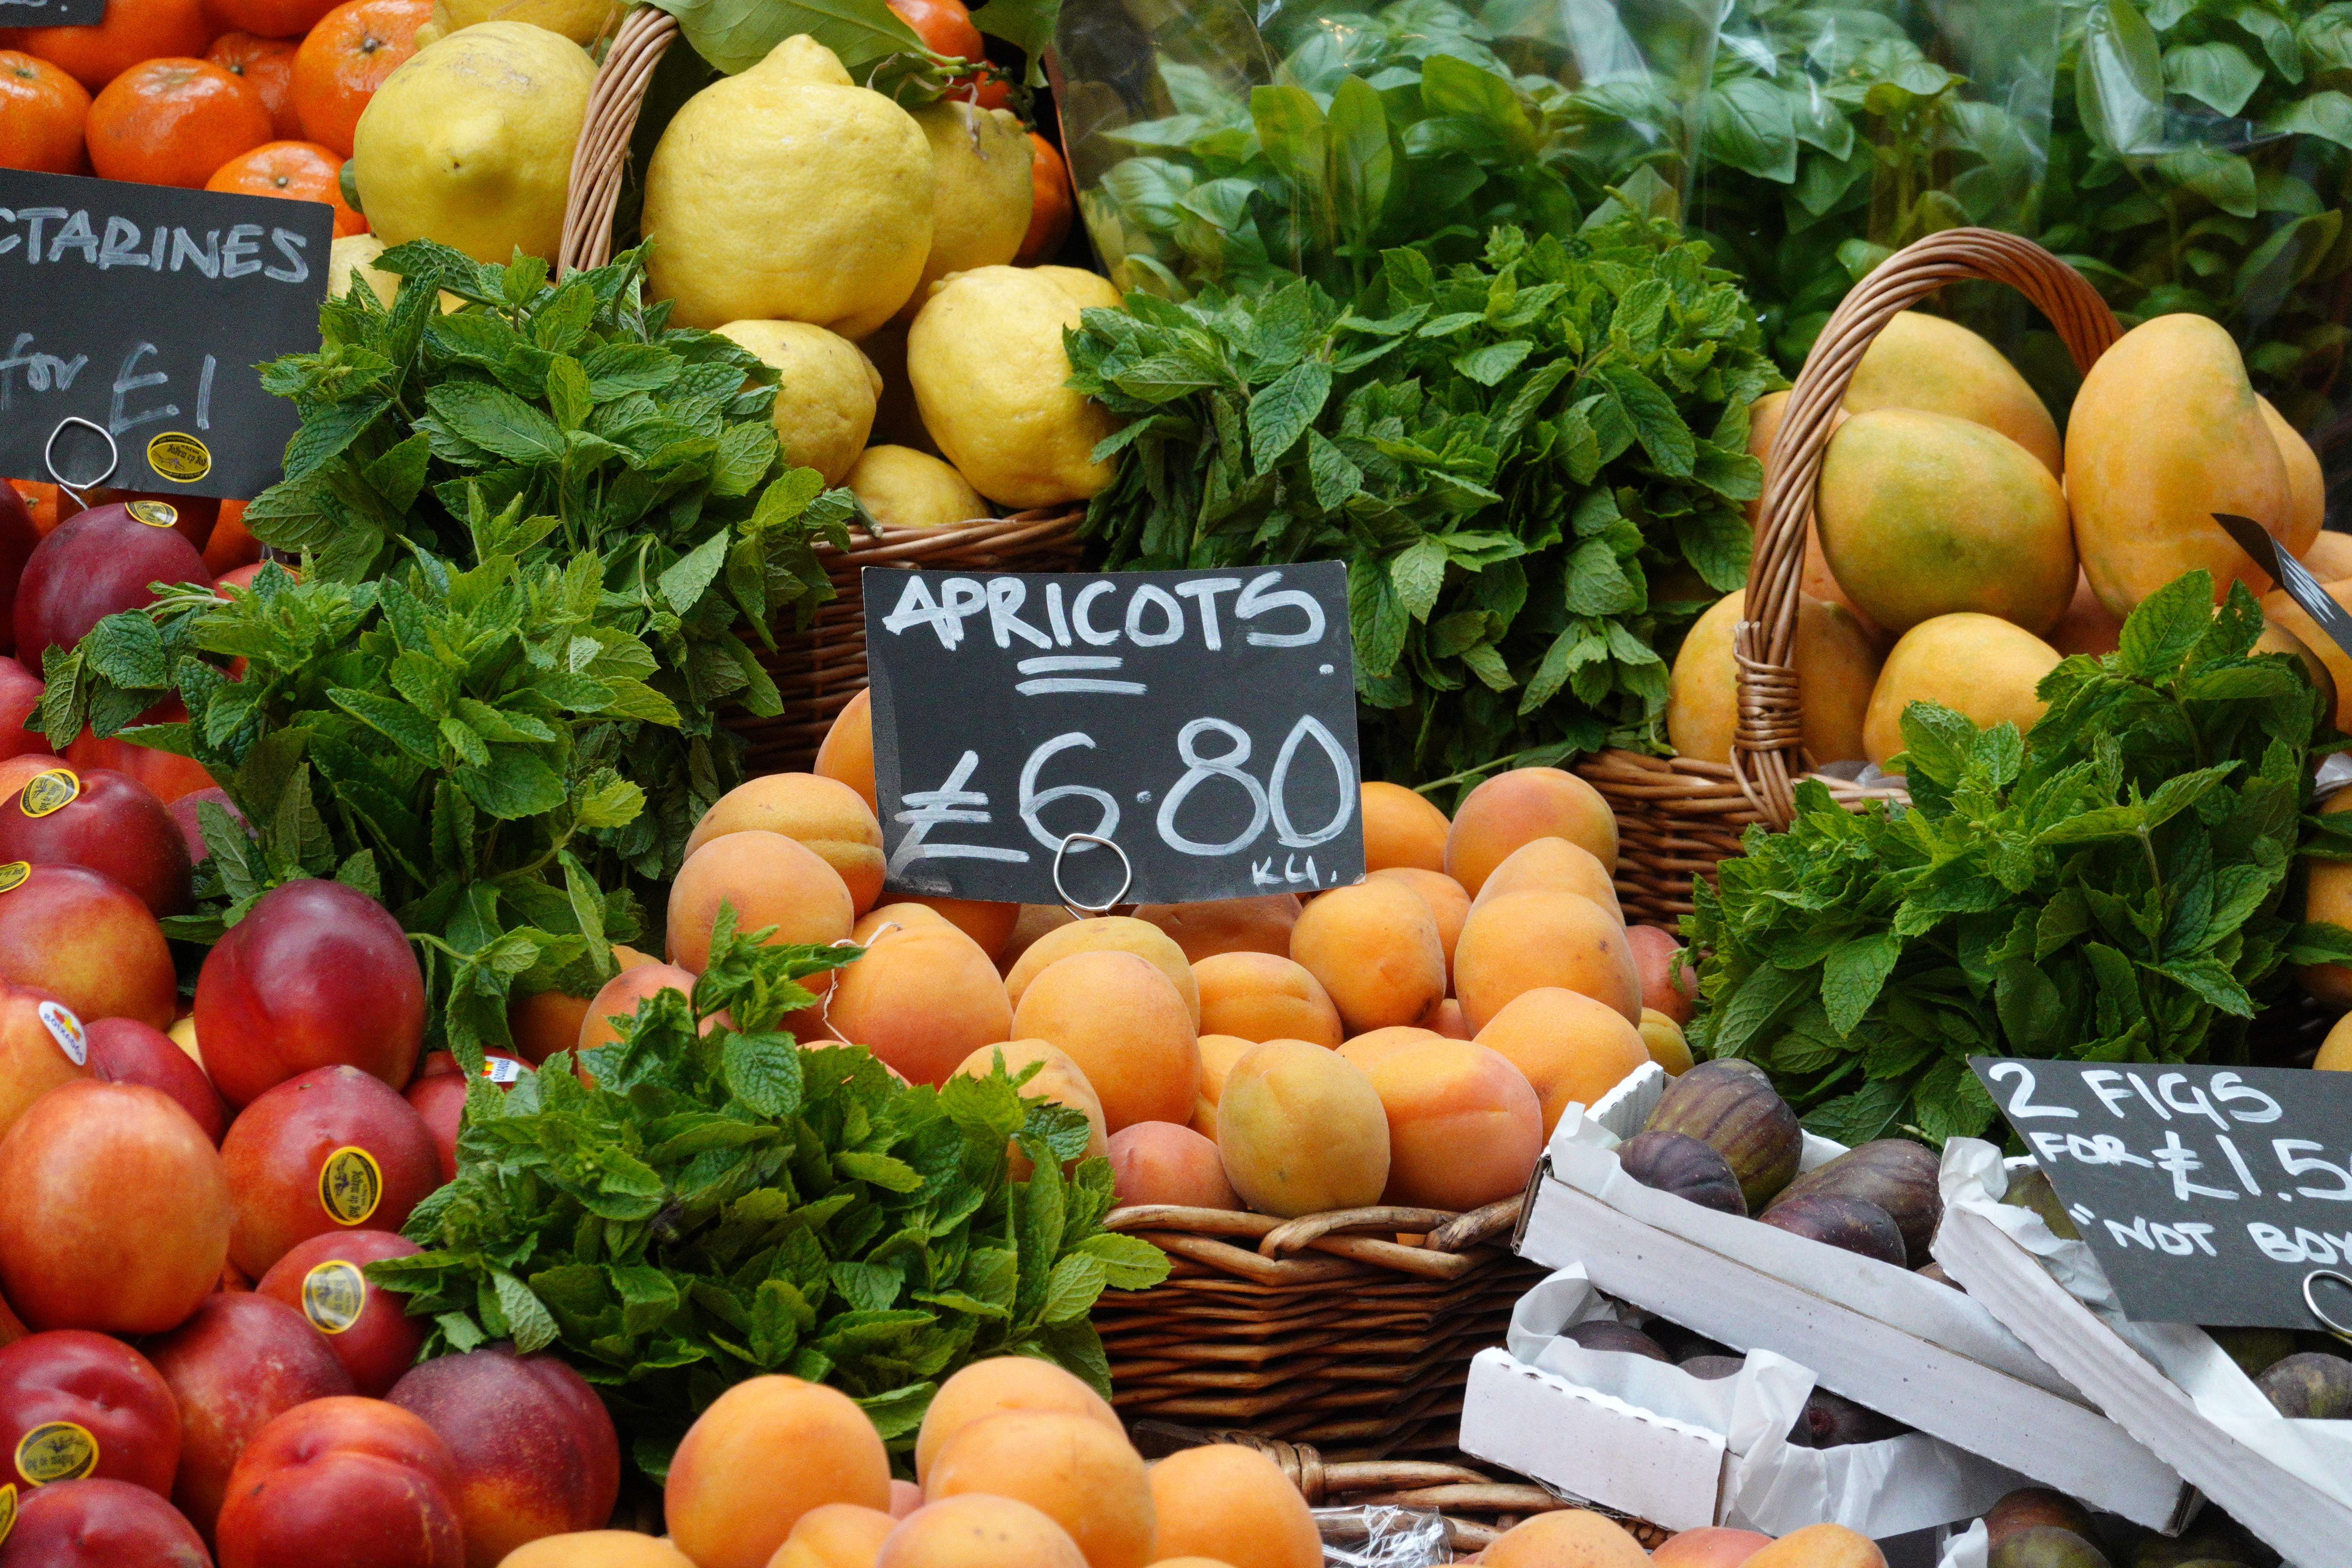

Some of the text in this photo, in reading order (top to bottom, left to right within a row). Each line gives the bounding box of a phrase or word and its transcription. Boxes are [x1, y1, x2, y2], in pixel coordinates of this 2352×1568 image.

[1988, 1062, 2283, 1131] 2 FIGS
[2029, 1130, 2352, 1201] FOR £1.5
